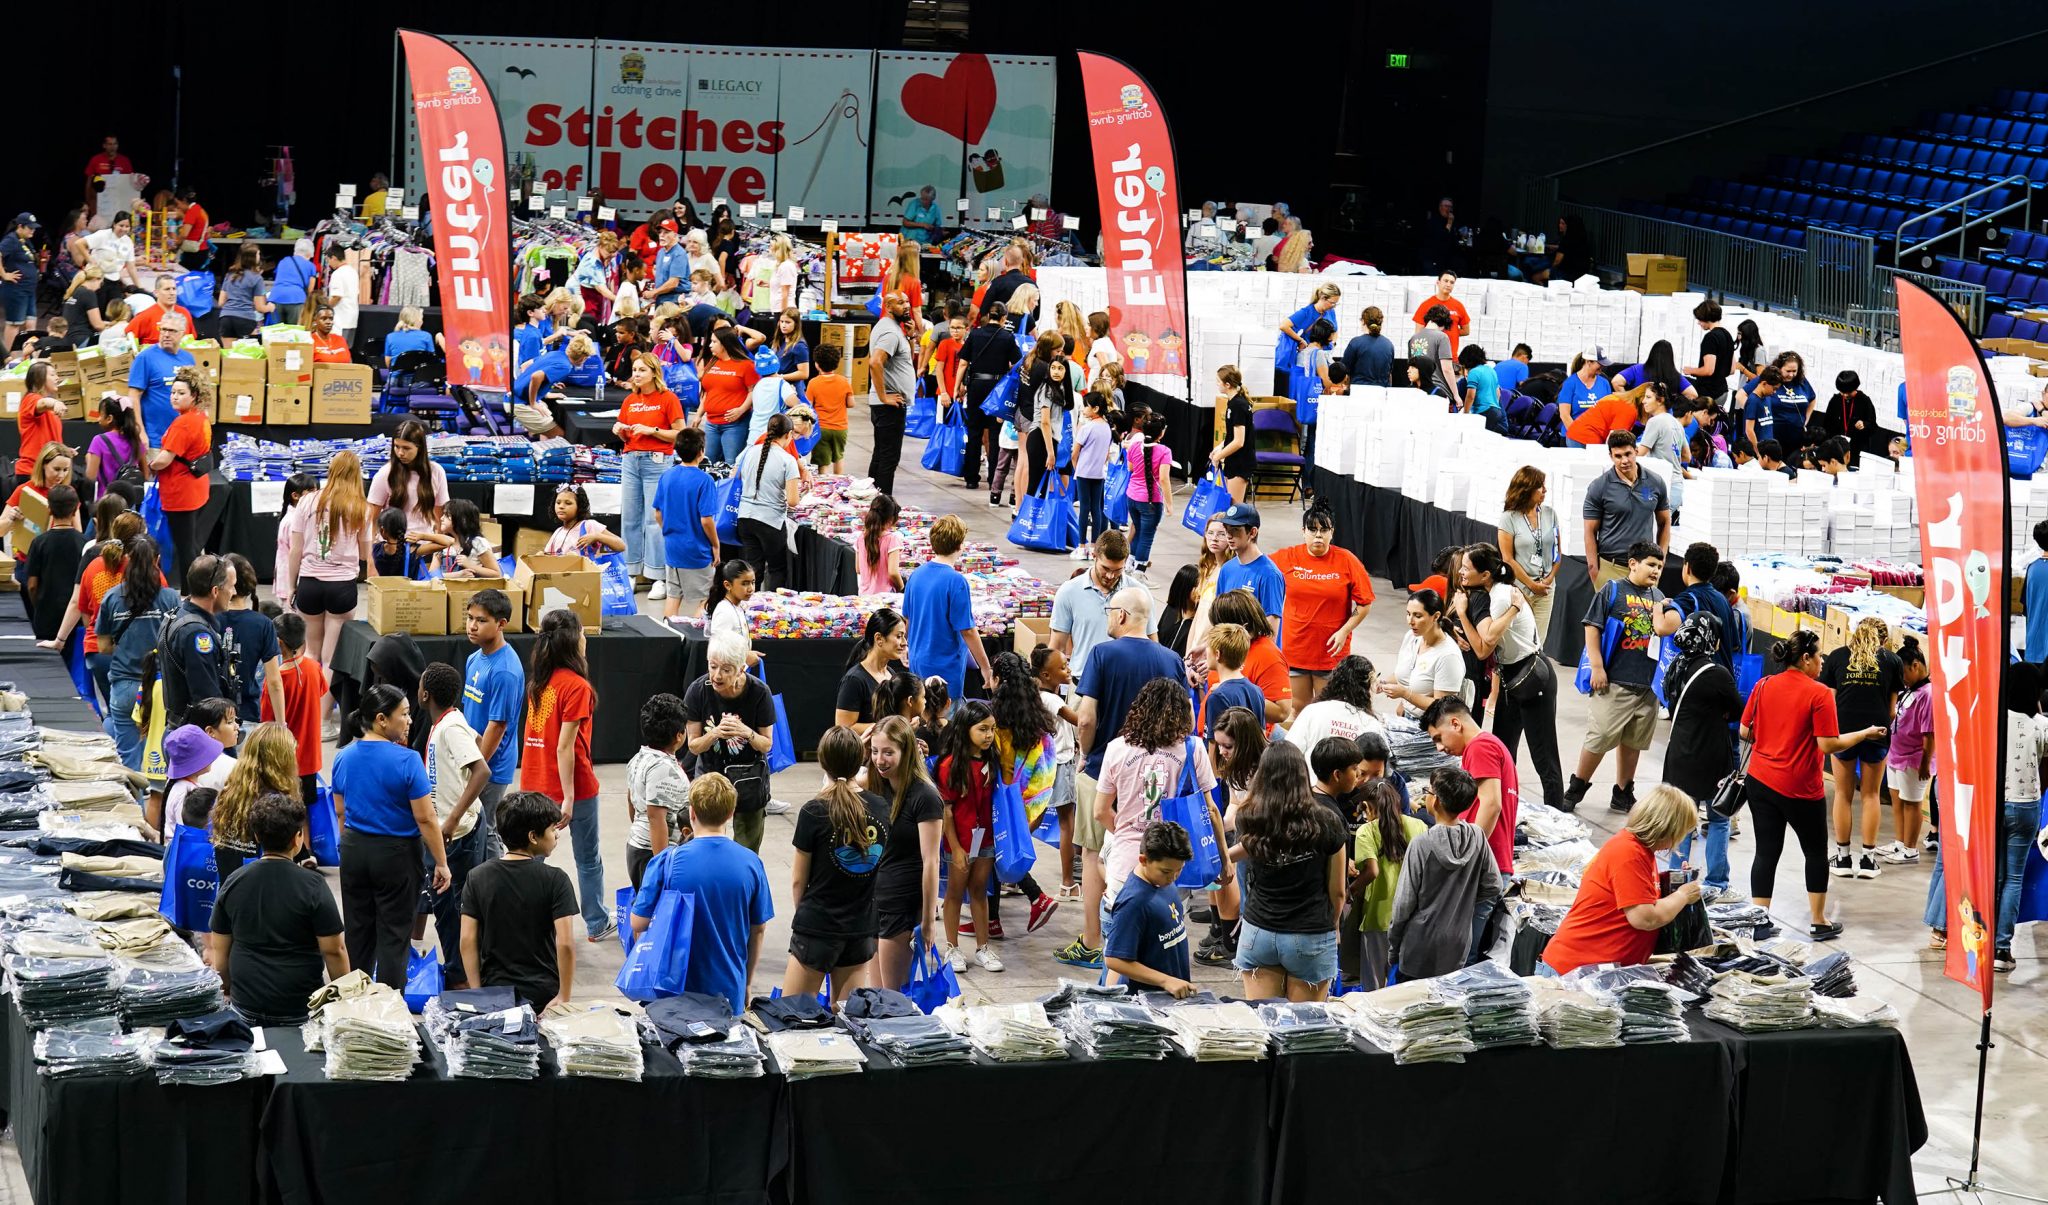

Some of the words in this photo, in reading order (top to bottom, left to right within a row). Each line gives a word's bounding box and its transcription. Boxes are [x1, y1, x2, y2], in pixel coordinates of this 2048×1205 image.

[1390, 54, 1407, 67] EXIT
[611, 84, 652, 98] clothing
[656, 85, 682, 97] drive
[711, 80, 763, 92] LEGACY
[525, 103, 785, 154] Stitches
[543, 164, 583, 191] of
[600, 151, 766, 205] Love
[1004, 400, 1016, 408] COX
[1846, 672, 1877, 680] FOREVER
[1331, 719, 1359, 732] WELLS
[1330, 728, 1359, 740] FARGO
[187, 878, 216, 890] COX
